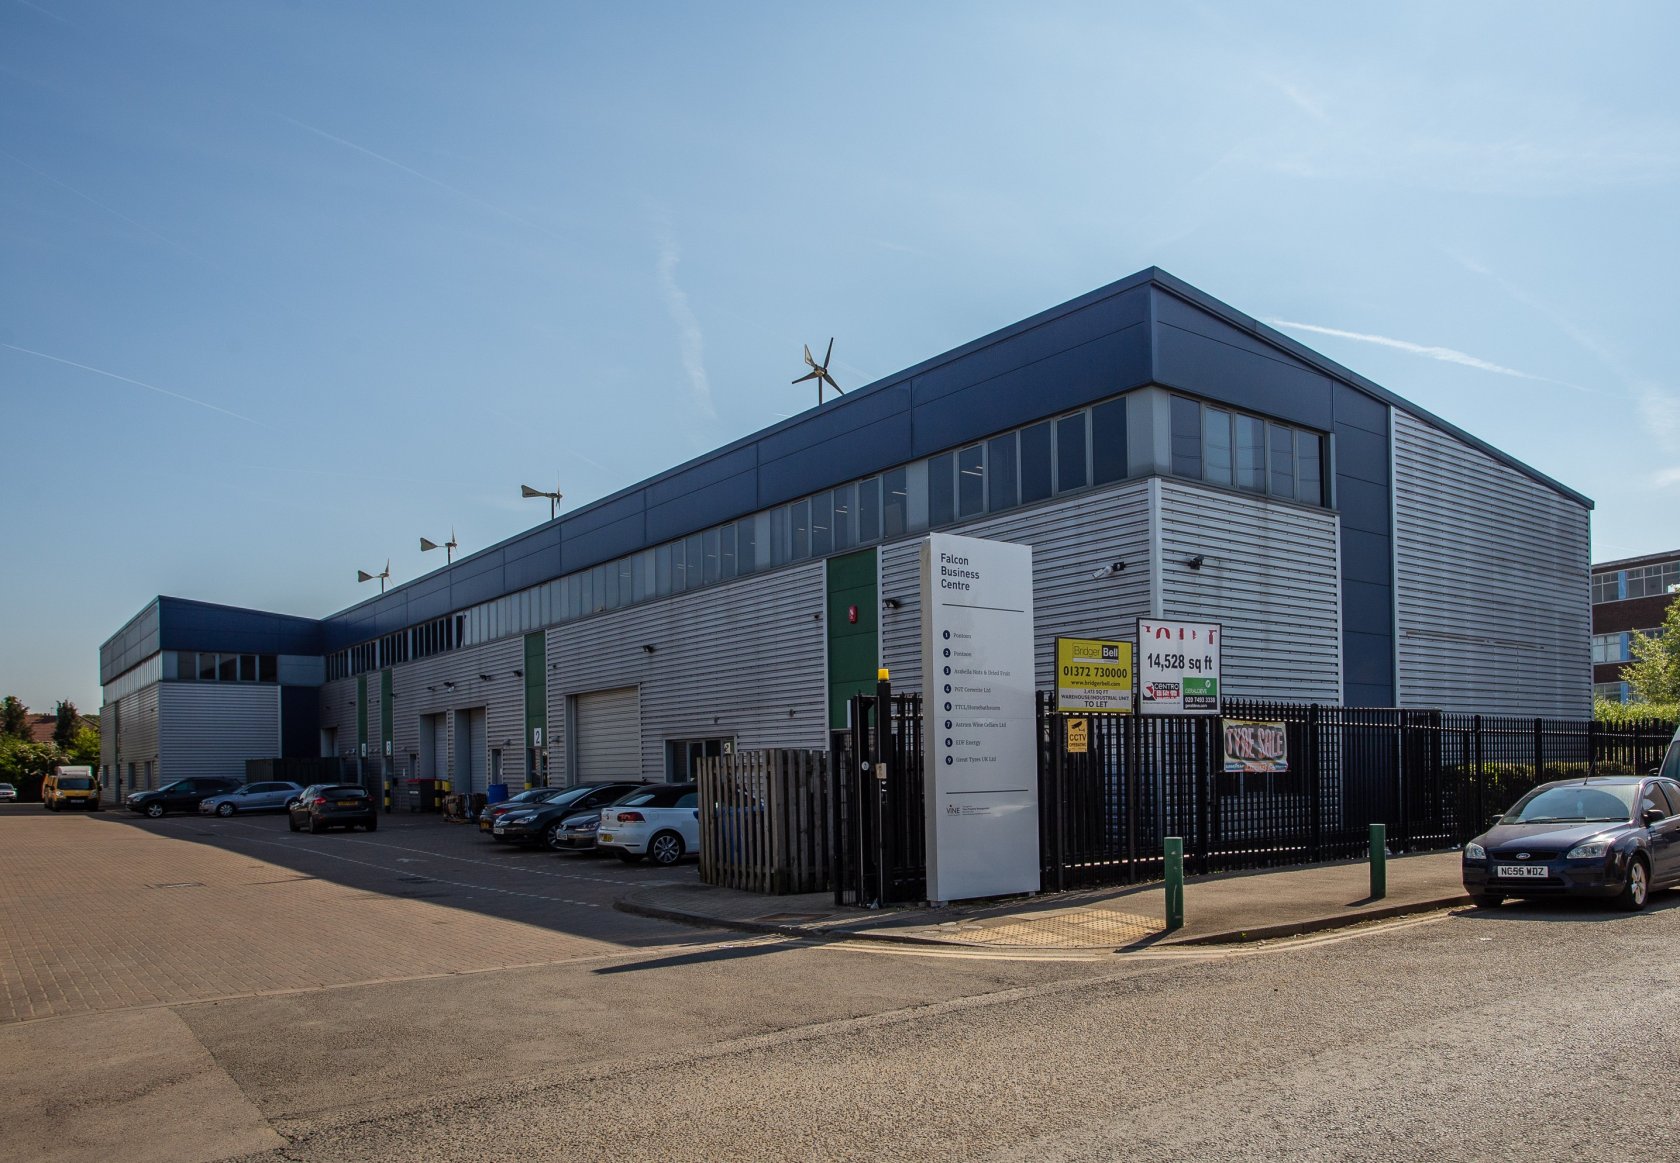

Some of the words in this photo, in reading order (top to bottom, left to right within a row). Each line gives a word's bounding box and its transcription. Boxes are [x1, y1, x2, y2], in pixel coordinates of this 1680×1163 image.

[941, 553, 969, 565] Falcon
[941, 566, 980, 579] Business
[941, 579, 970, 590] Centre
[1073, 645, 1100, 657] Bridger
[1103, 647, 1118, 657] Bell
[1147, 653, 1185, 672] 14,528
[1188, 658, 1202, 673] sq
[1204, 655, 1213, 670] ft
[1063, 666, 1091, 677] 01372
[1094, 667, 1128, 678] 730000
[1069, 733, 1087, 741] CCTV
[1226, 728, 1255, 758] TYRE
[1258, 728, 1283, 758] SALE
[946, 805, 960, 814] VINE
[1526, 867, 1545, 876] WDZ
